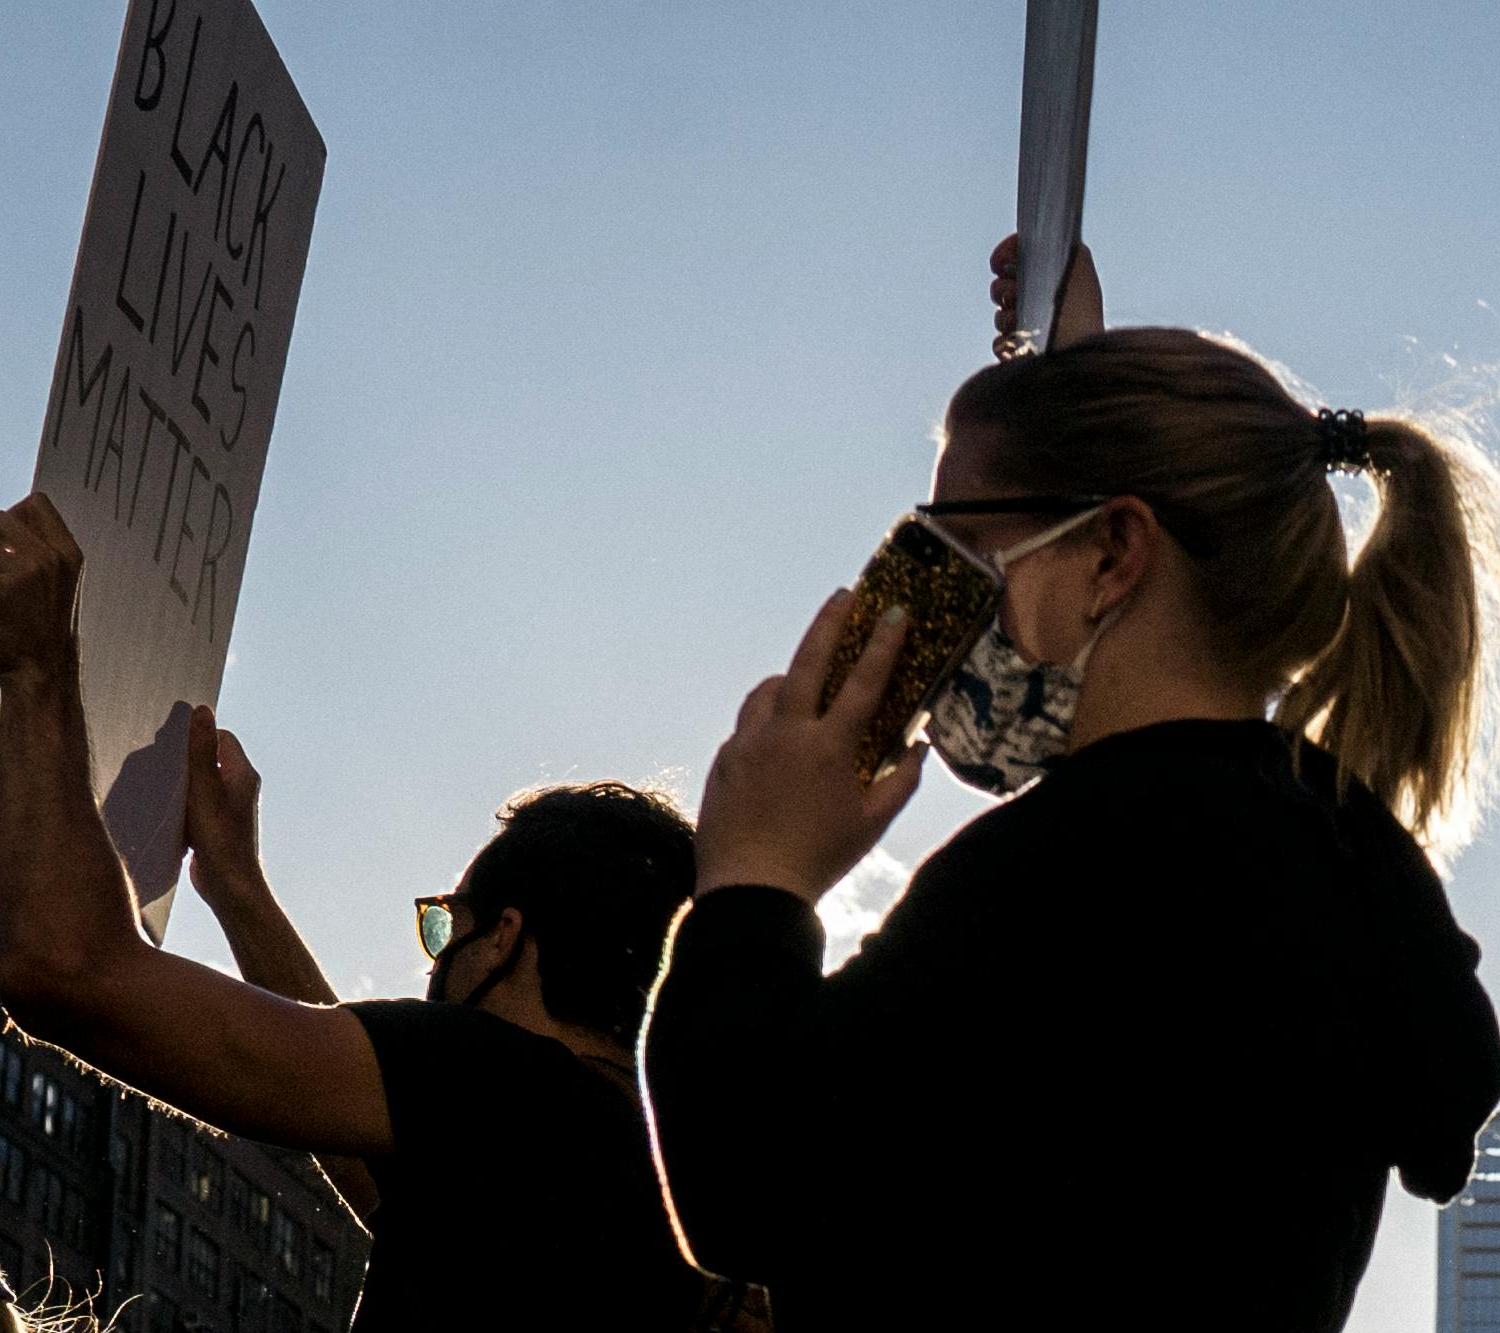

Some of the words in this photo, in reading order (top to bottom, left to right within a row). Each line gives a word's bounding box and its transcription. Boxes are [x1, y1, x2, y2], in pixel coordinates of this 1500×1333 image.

[115, 169, 256, 453] LIVES
[134, 0, 285, 311] BLACK
[51, 304, 233, 644] MATTER
